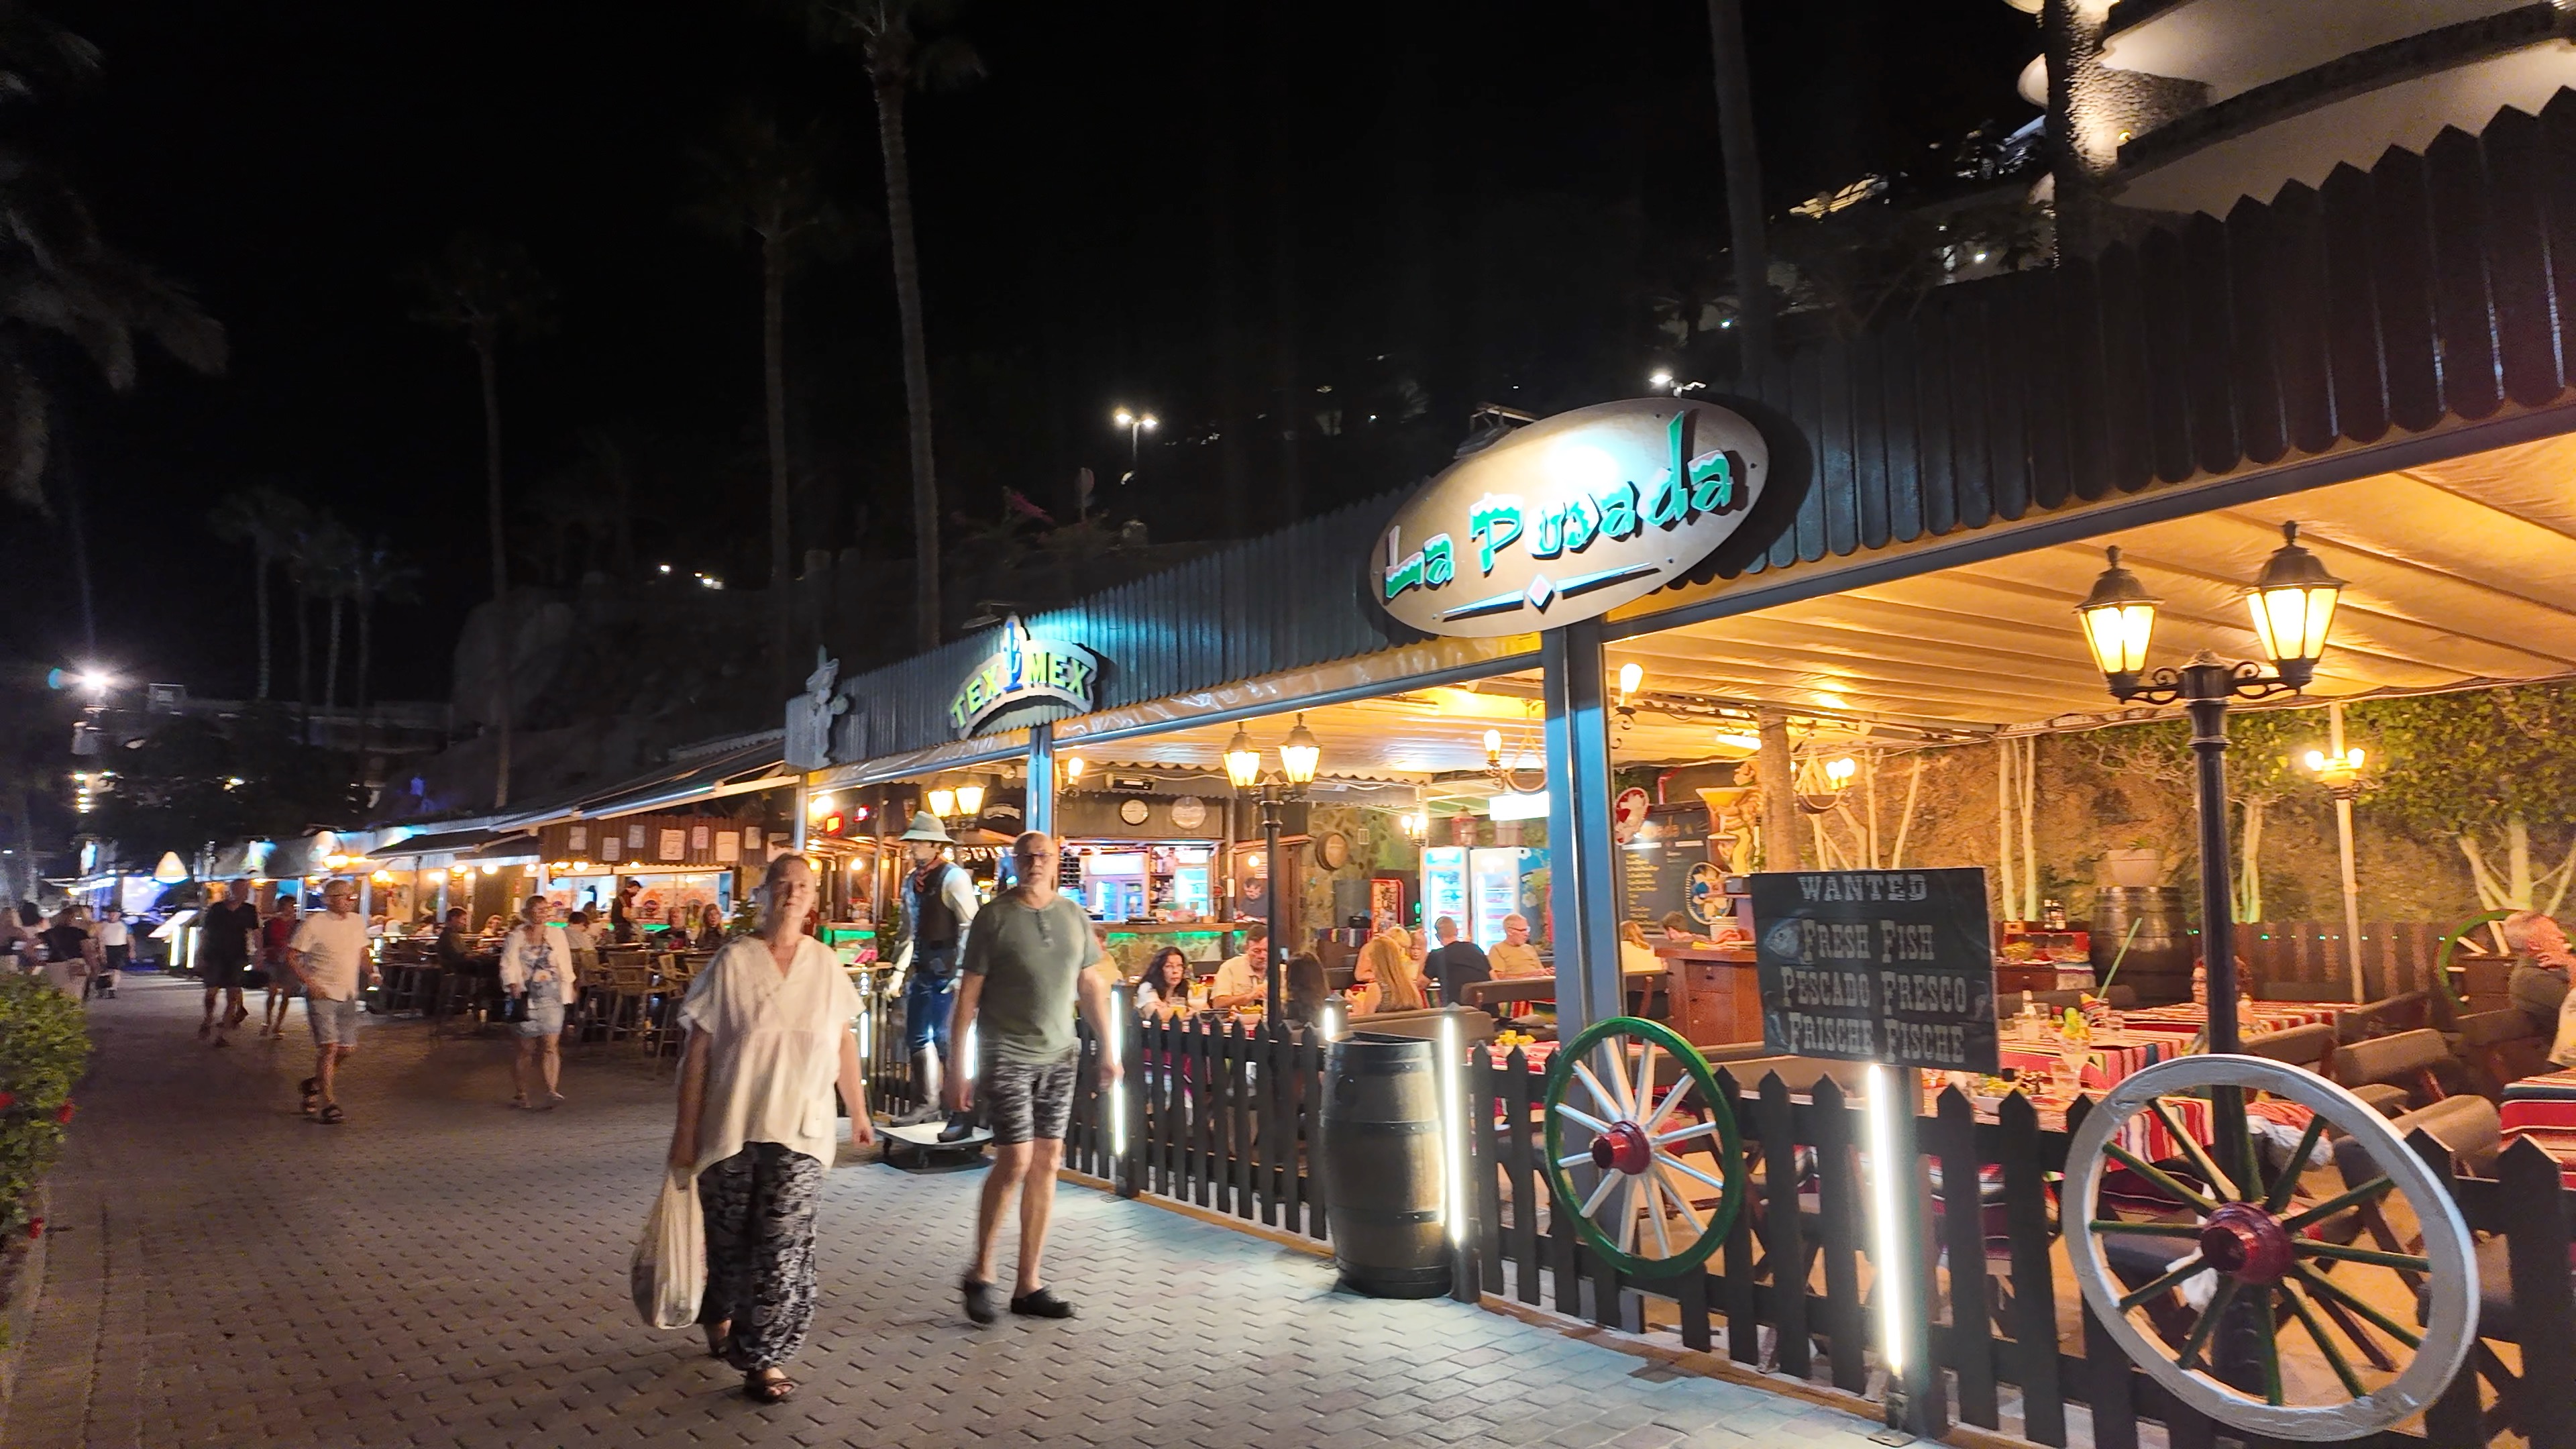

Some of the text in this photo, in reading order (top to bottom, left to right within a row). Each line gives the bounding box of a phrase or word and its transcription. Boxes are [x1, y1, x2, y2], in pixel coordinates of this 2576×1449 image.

[1385, 525, 1455, 599] La
[950, 652, 1090, 729] TEX MEX
[1798, 874, 1927, 902] WANTED
[1801, 920, 1935, 963] FRESH FISH
[1780, 966, 1967, 1016] PESCADO FRESCO
[1884, 1018, 1966, 1063] FISCHE
